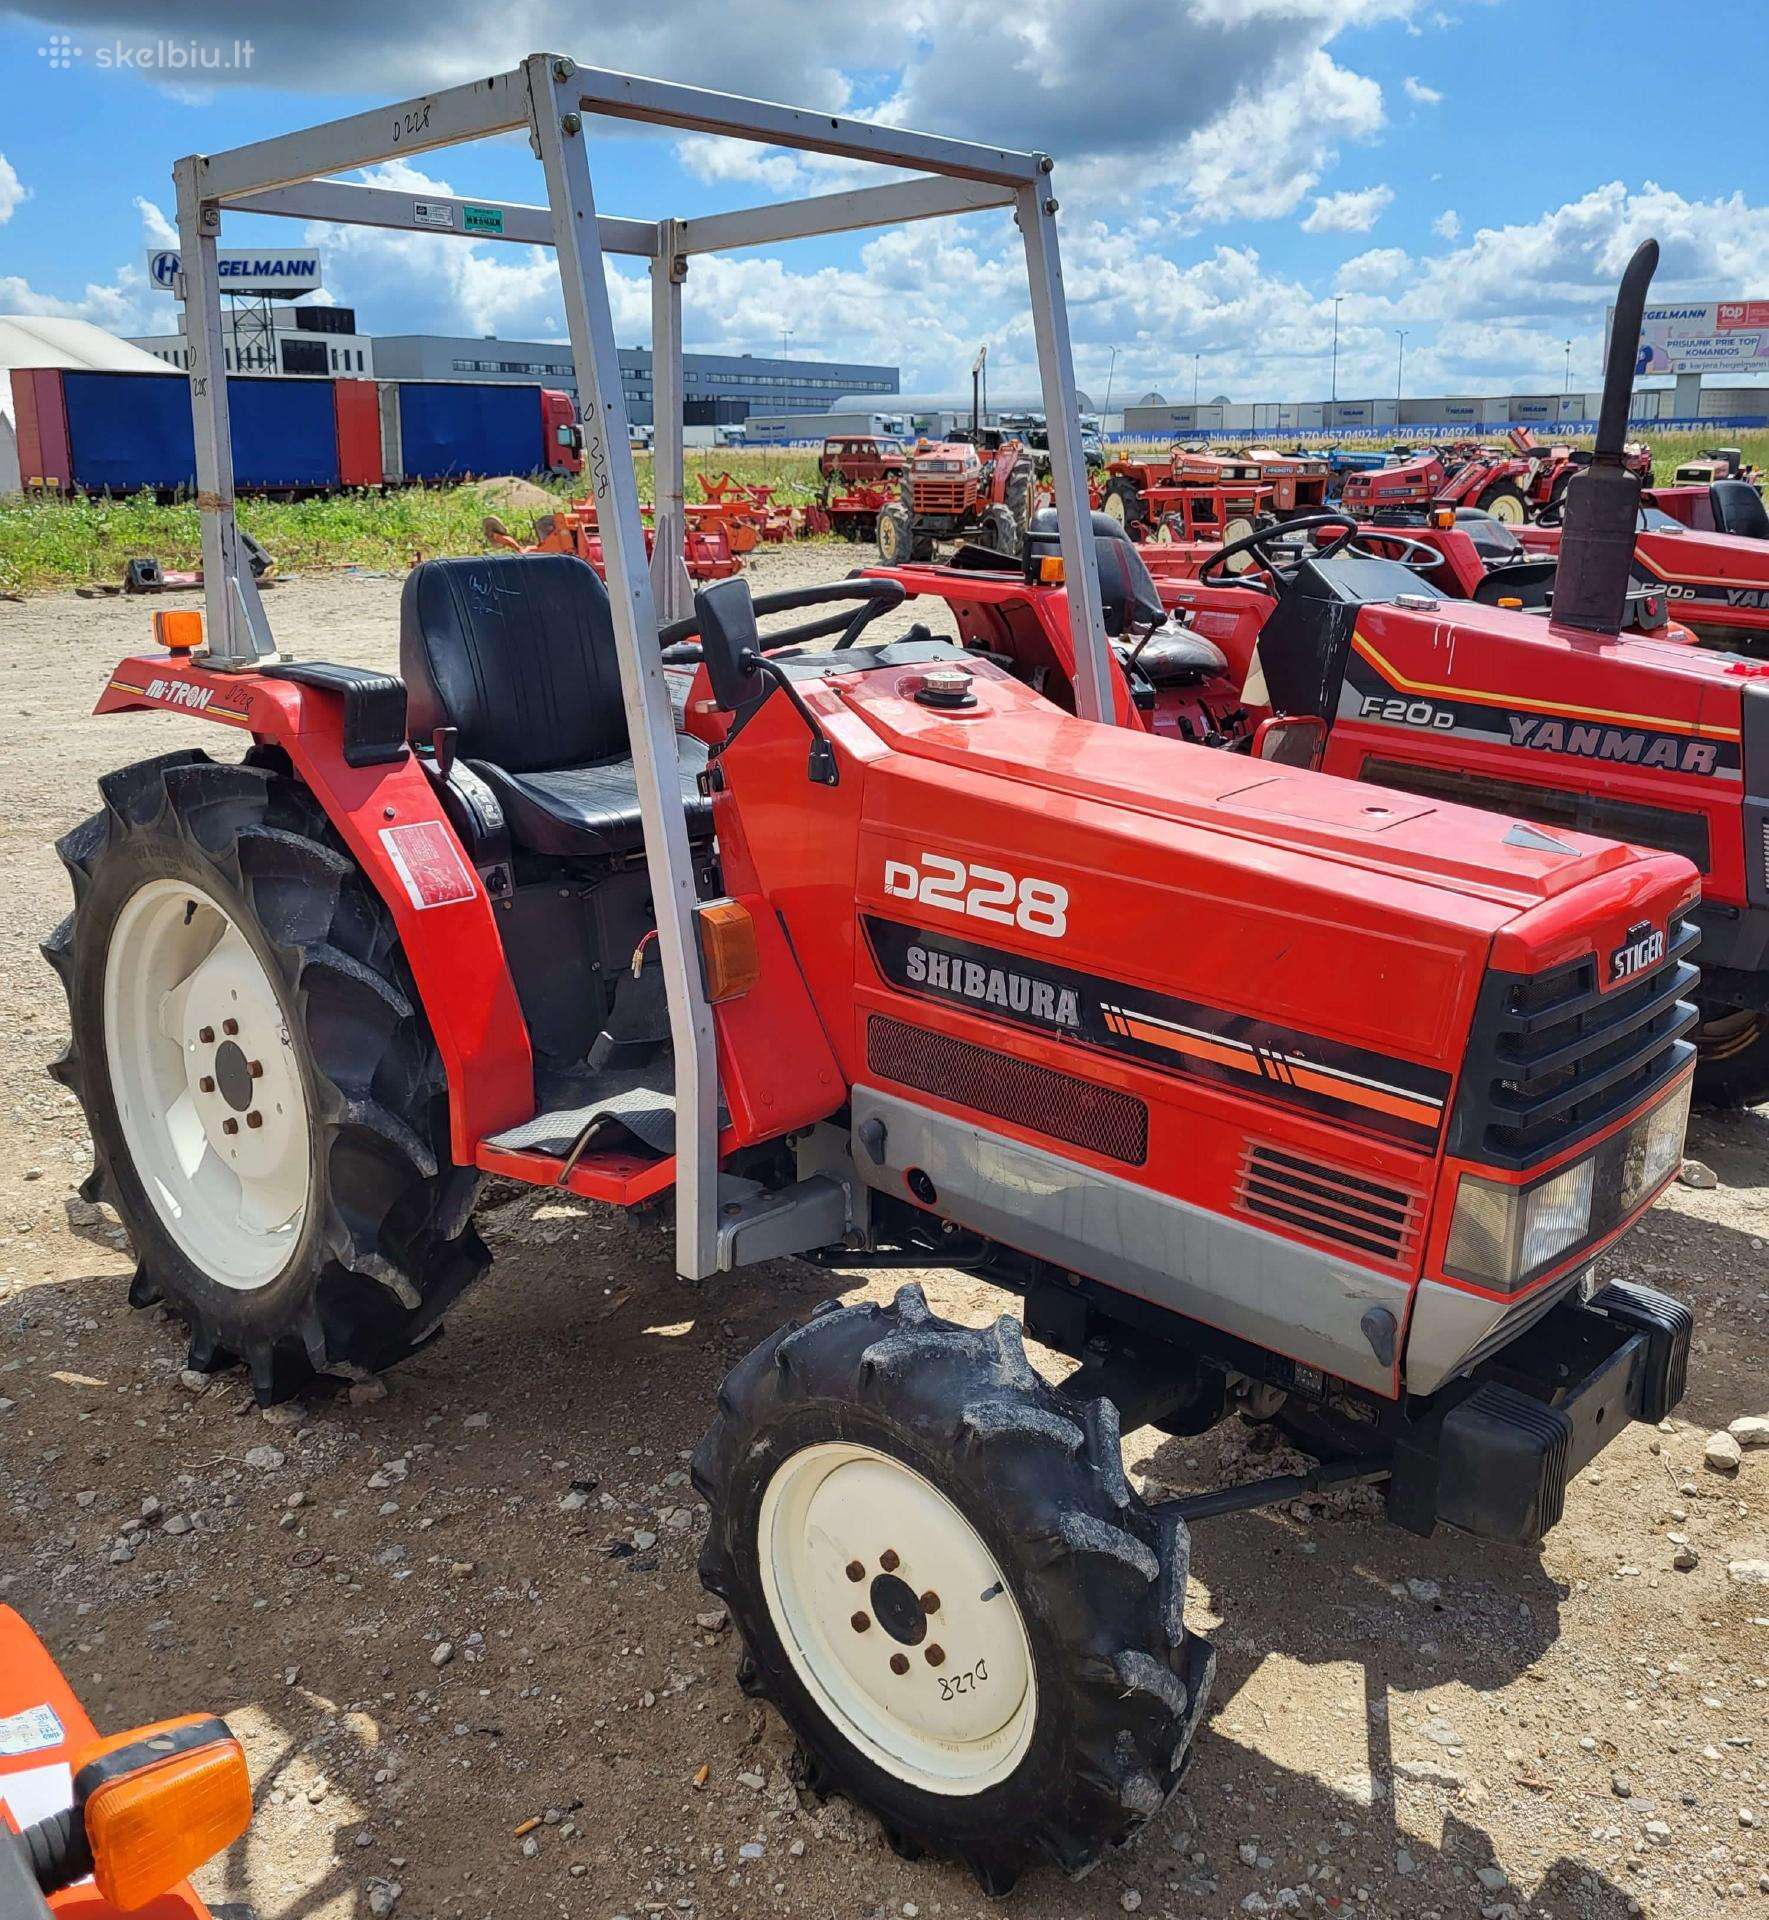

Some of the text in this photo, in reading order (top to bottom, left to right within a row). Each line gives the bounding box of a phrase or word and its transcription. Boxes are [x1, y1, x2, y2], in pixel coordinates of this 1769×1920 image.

[404, 103, 431, 134] 228
[218, 260, 317, 277] GELMANN
[1686, 348, 1740, 356] KOMANDOS
[1739, 337, 1758, 346] TOP
[1508, 716, 1717, 774] YANMAR
[884, 852, 1069, 938] D228
[1614, 931, 1664, 980] STIGER
[906, 945, 1080, 1028] SHIBAURA
